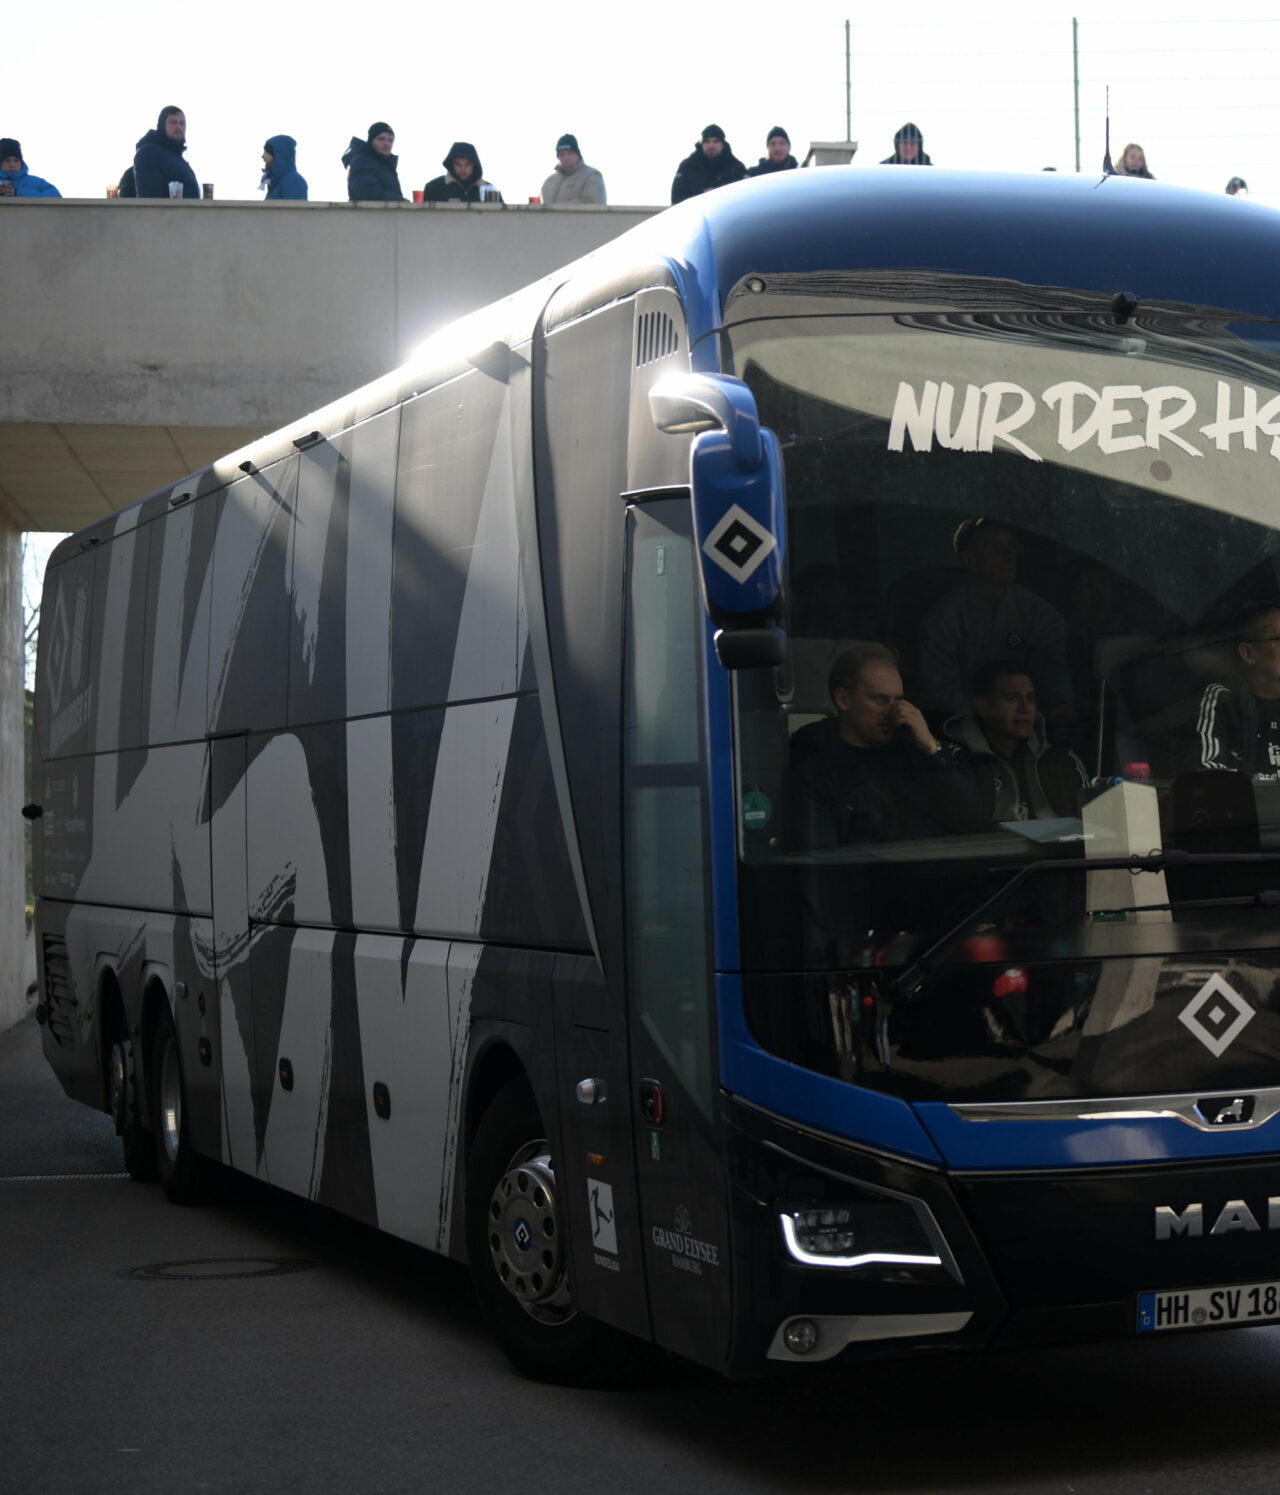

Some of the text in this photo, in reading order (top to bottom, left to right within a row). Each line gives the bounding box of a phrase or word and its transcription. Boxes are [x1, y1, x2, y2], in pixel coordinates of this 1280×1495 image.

[887, 380, 1043, 462] NUR
[1041, 380, 1204, 458] DER
[652, 1226, 684, 1254] GRAND
[1156, 1294, 1190, 1327] HH
[1209, 1289, 1242, 1321] SV
